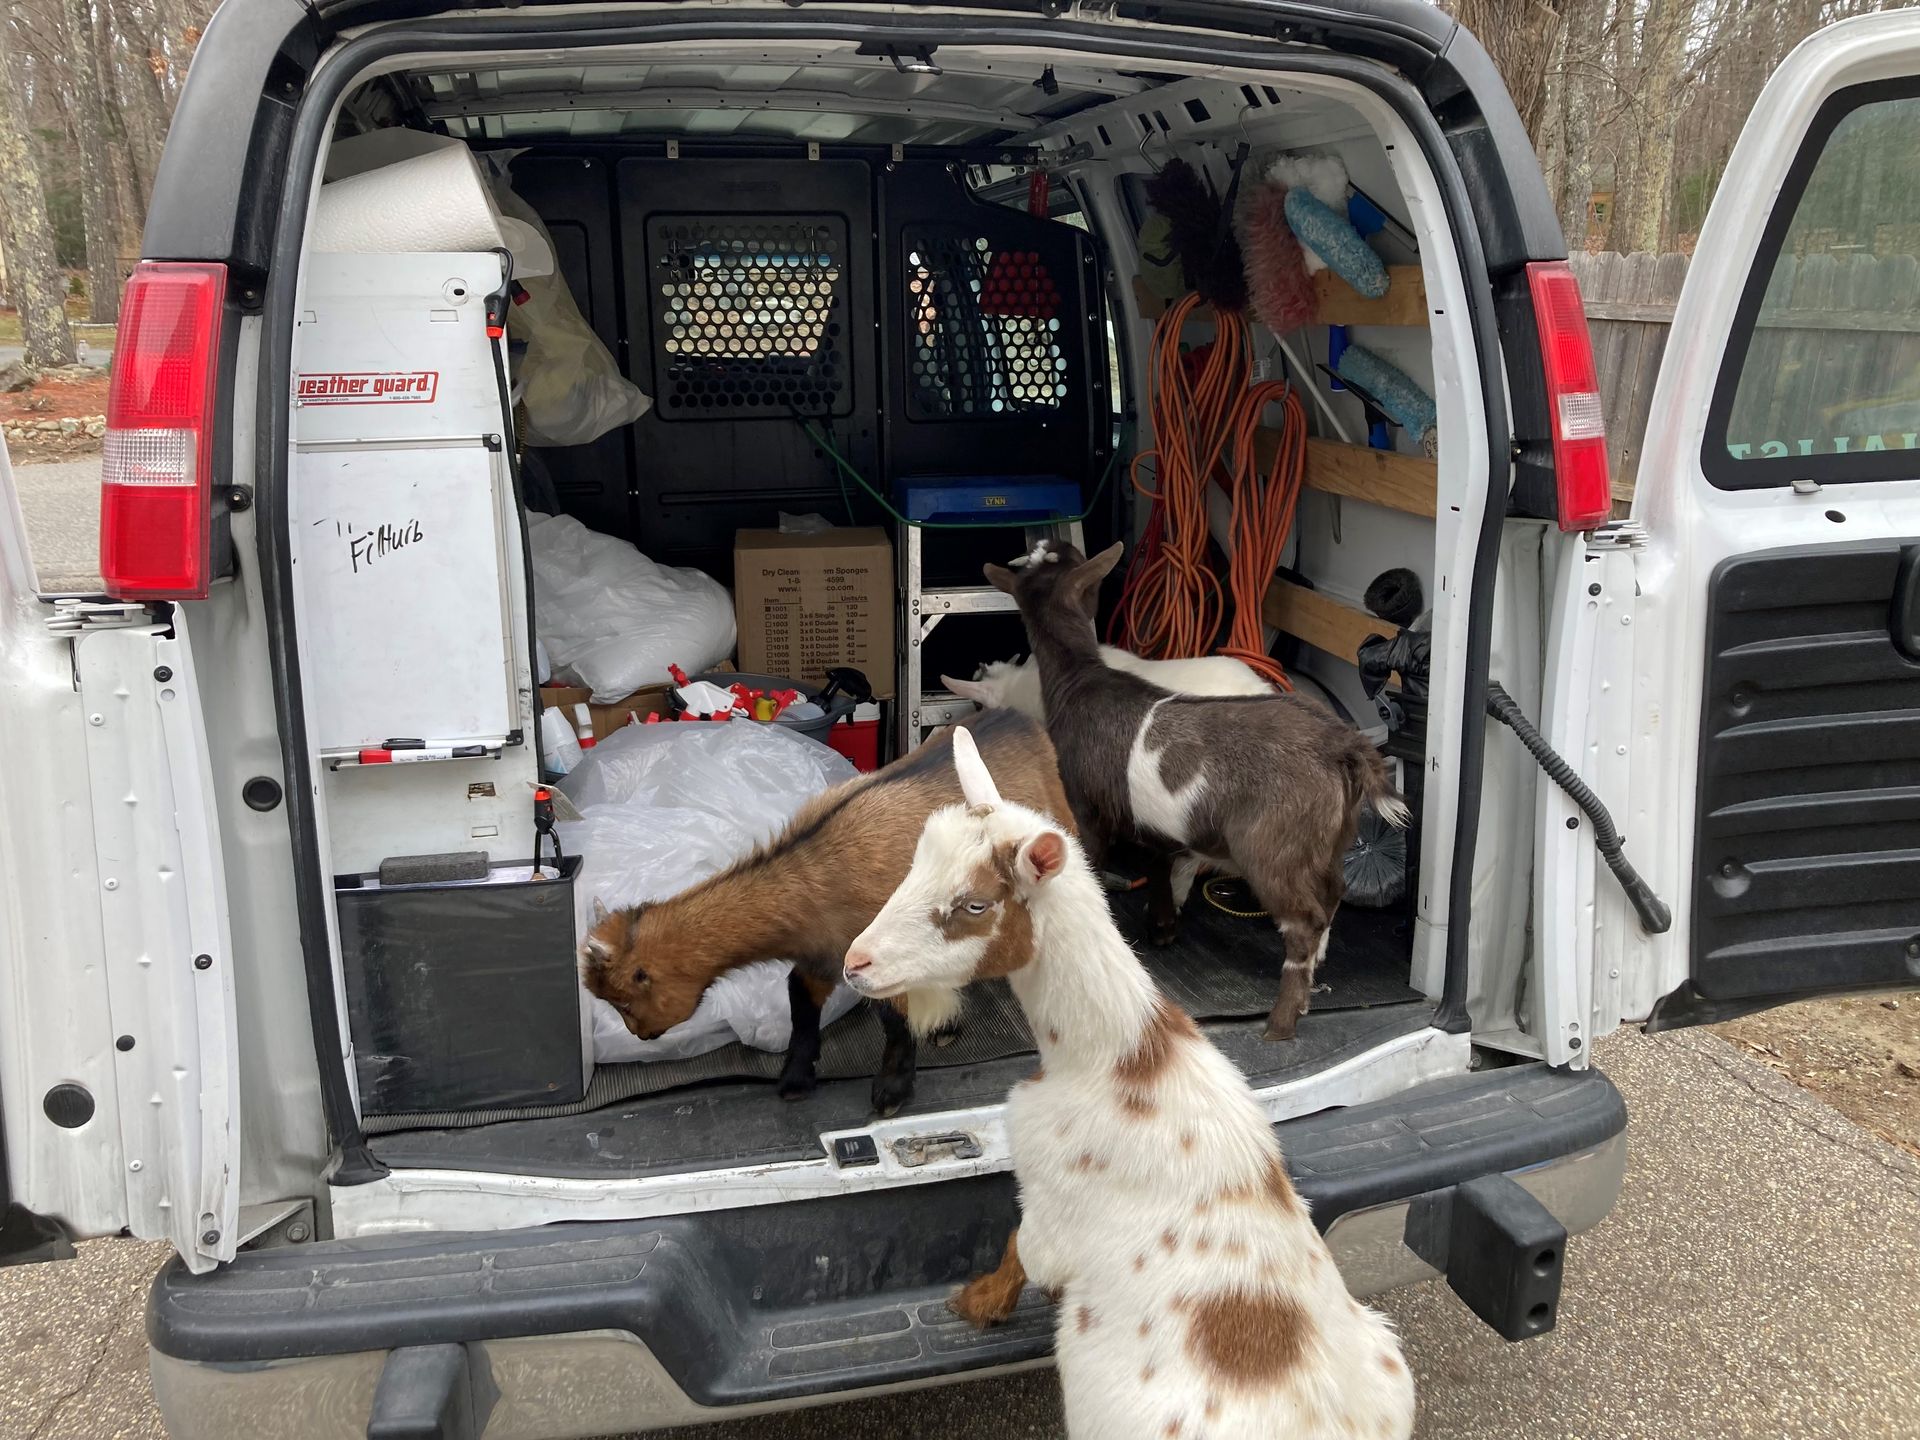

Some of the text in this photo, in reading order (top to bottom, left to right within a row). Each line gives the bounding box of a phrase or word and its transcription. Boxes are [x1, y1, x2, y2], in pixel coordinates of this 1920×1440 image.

[373, 374, 429, 396] guard
[762, 569, 776, 577] Dry
[836, 567, 869, 575] Sponges
